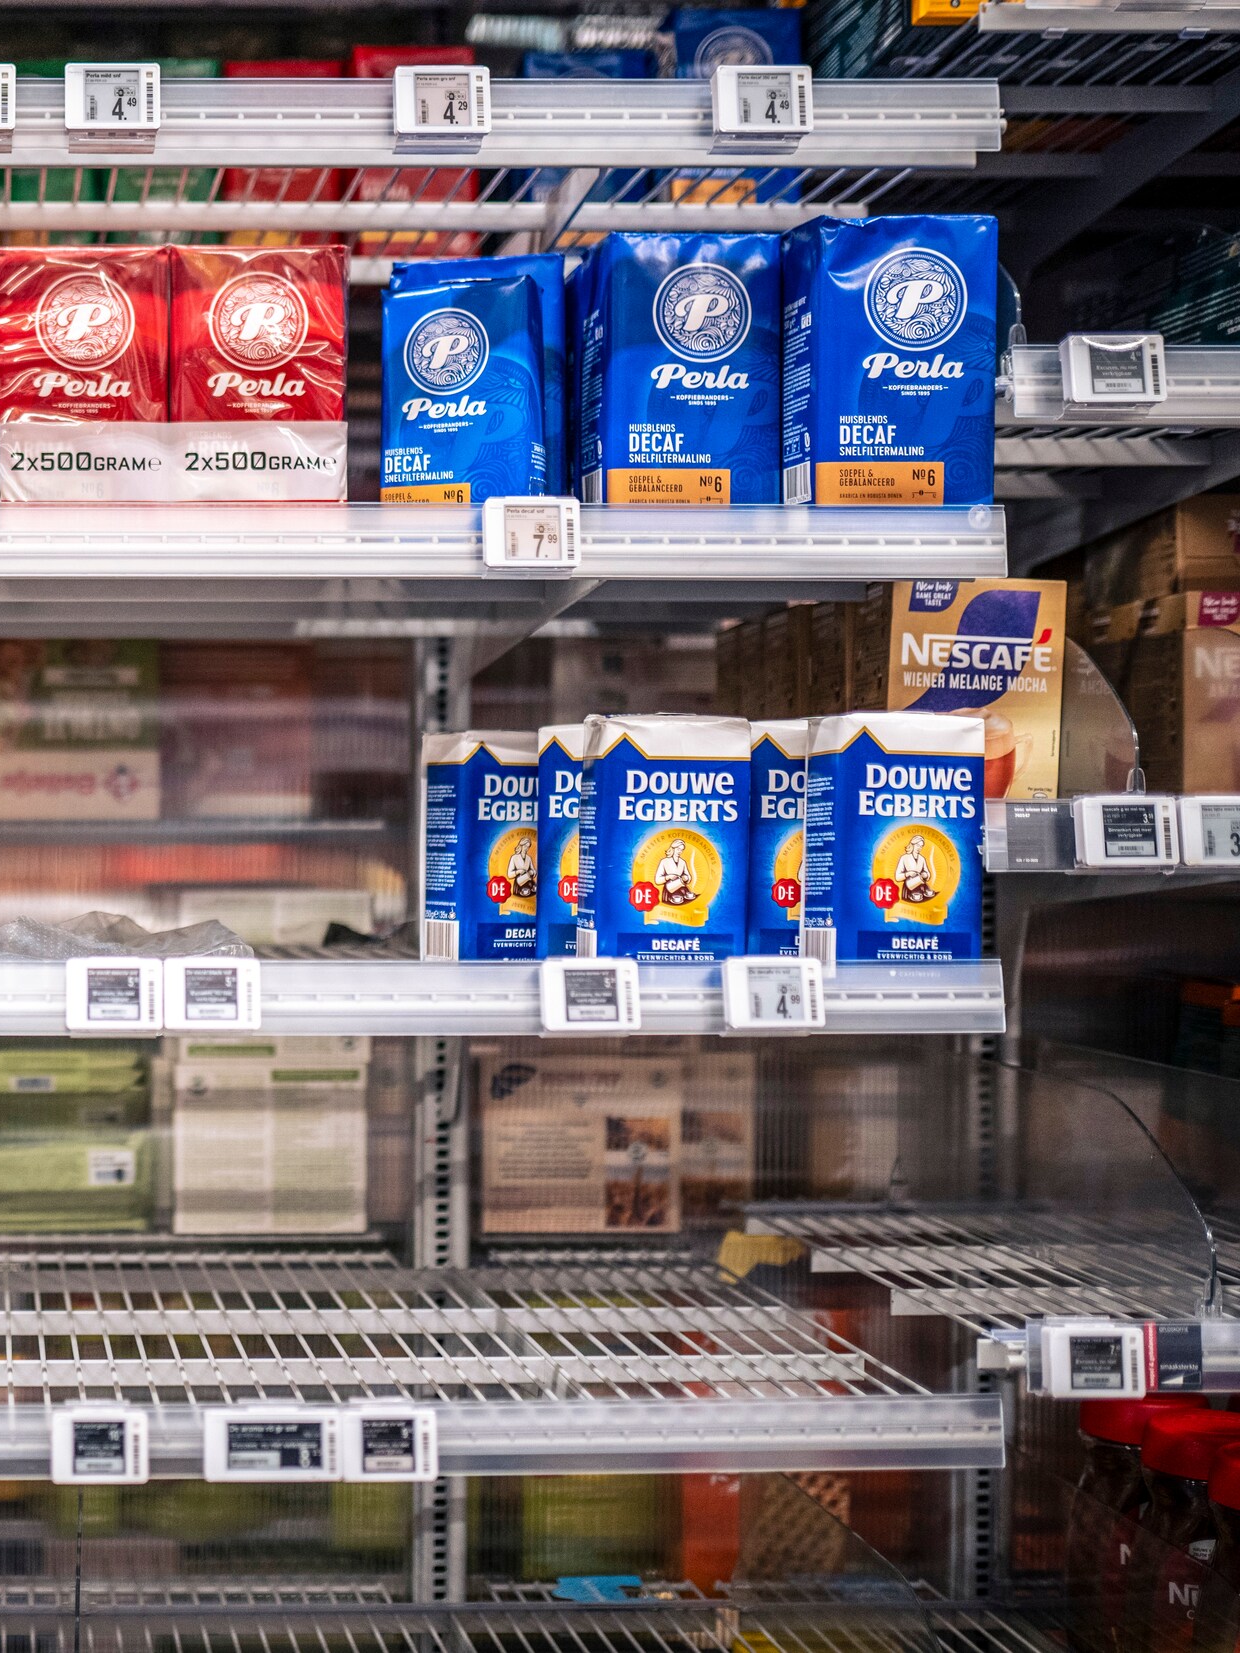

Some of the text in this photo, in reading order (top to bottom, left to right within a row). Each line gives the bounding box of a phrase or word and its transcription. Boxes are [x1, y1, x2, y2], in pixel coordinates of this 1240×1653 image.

[863, 353, 965, 380] Perla
[33, 372, 132, 397] Perla
[207, 372, 306, 397] Perla
[650, 364, 750, 391] Perla
[401, 395, 487, 421] Perla
[629, 423, 676, 433] HUISBLENDS
[839, 415, 888, 424] HUISBLENDS
[629, 433, 684, 452] DECAF
[839, 424, 897, 445] DECAF
[384, 446, 423, 456] HUISBLENDS
[629, 453, 711, 464] SNELFILTERMALING
[839, 445, 924, 456] SNELFILTERMALING
[384, 455, 431, 474] DECAF
[839, 468, 874, 477] SOEPEL &
[384, 471, 454, 483] SNELFILTERMALING
[629, 475, 662, 484] SOEPEL &
[839, 477, 895, 487] GEBALANCEERD
[629, 484, 683, 493] GEBALANCEERD
[901, 628, 1053, 673] NESCAFÉ
[903, 671, 1048, 693] WIENER MELANGE MOCHA
[618, 796, 738, 822] EGBERTS
[858, 791, 976, 818] EGBERTS
[651, 937, 701, 952] DECAFÉ
[892, 936, 939, 950] DECAFÉ
